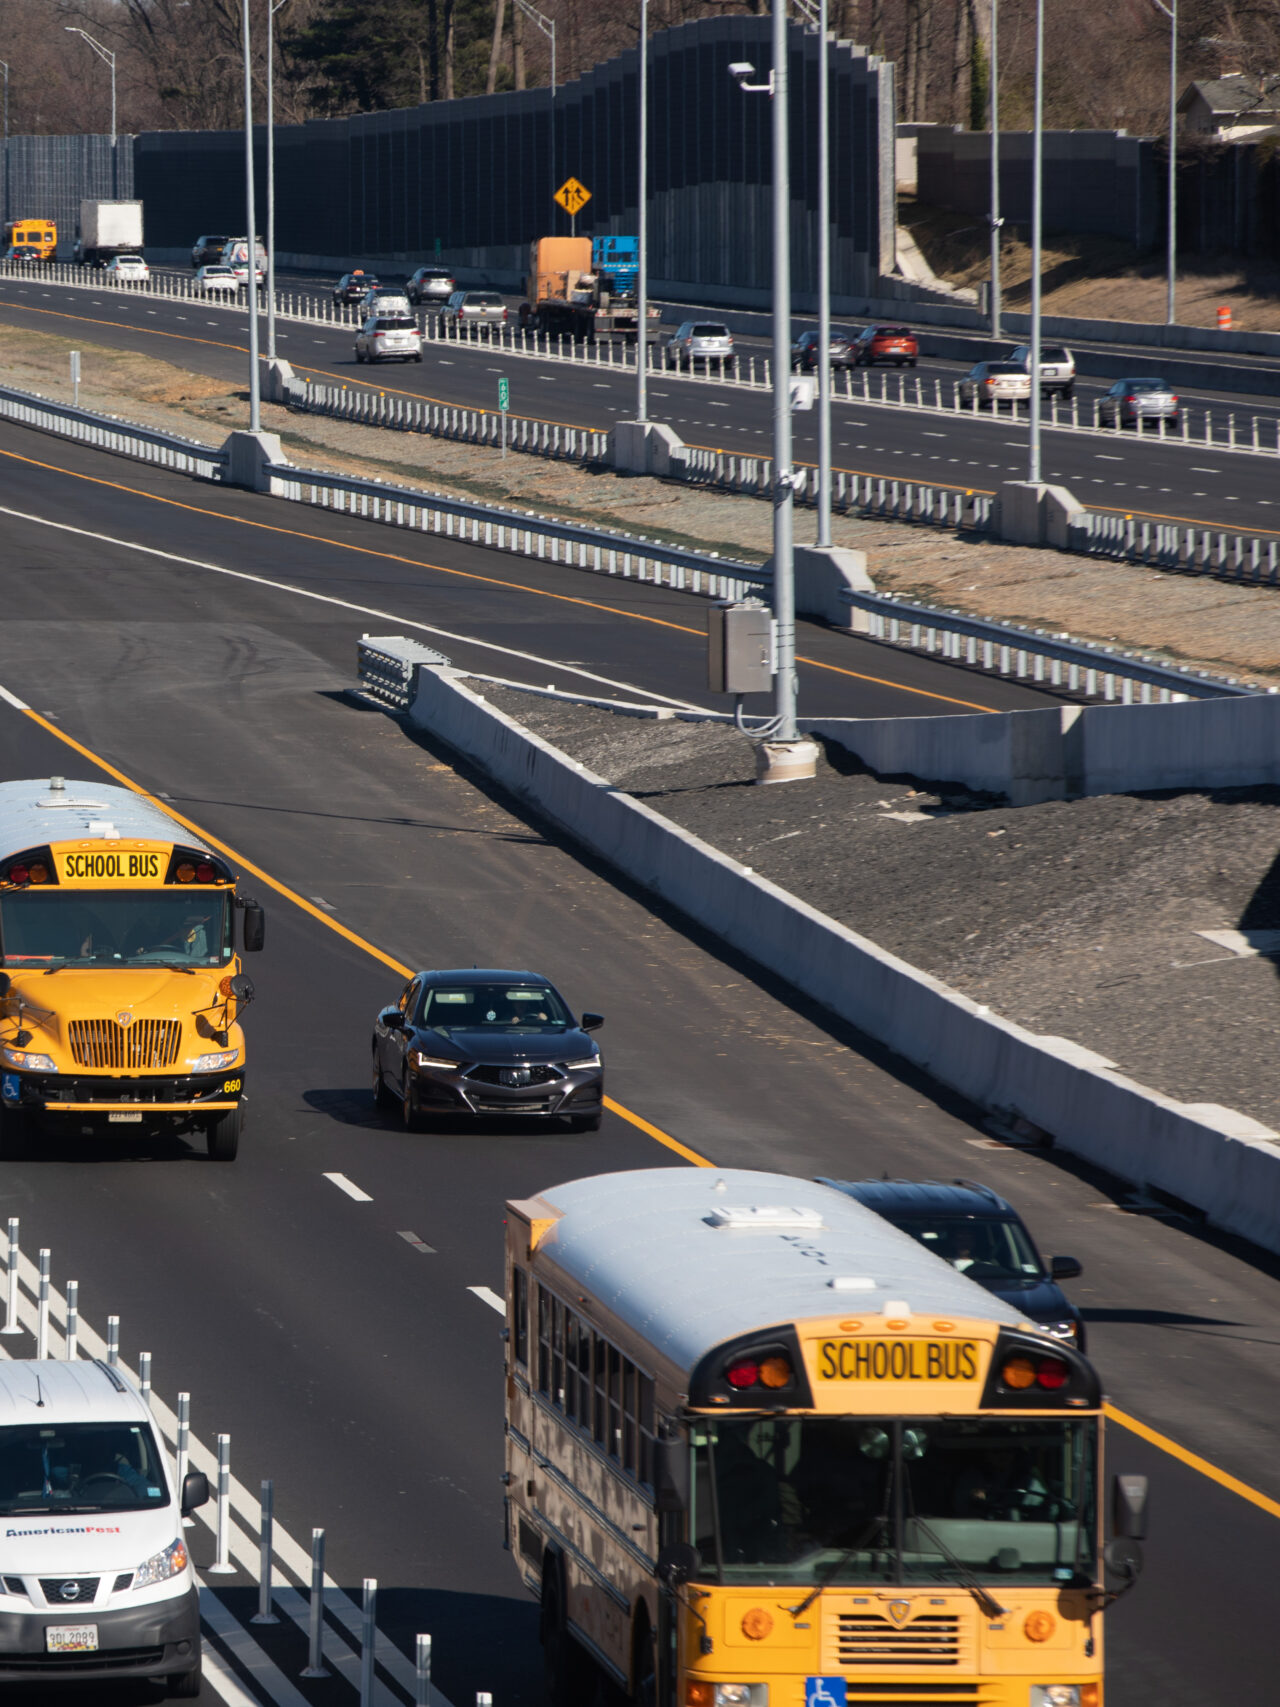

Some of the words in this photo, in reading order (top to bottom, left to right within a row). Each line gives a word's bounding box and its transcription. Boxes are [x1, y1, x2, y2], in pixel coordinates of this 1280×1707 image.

[65, 854, 125, 878] SCHOOL
[128, 854, 159, 878] BUS
[223, 1078, 241, 1094] 660
[821, 1342, 923, 1380] SCHOOL
[927, 1342, 977, 1380] BUS
[5, 1526, 120, 1538] AmericanPest
